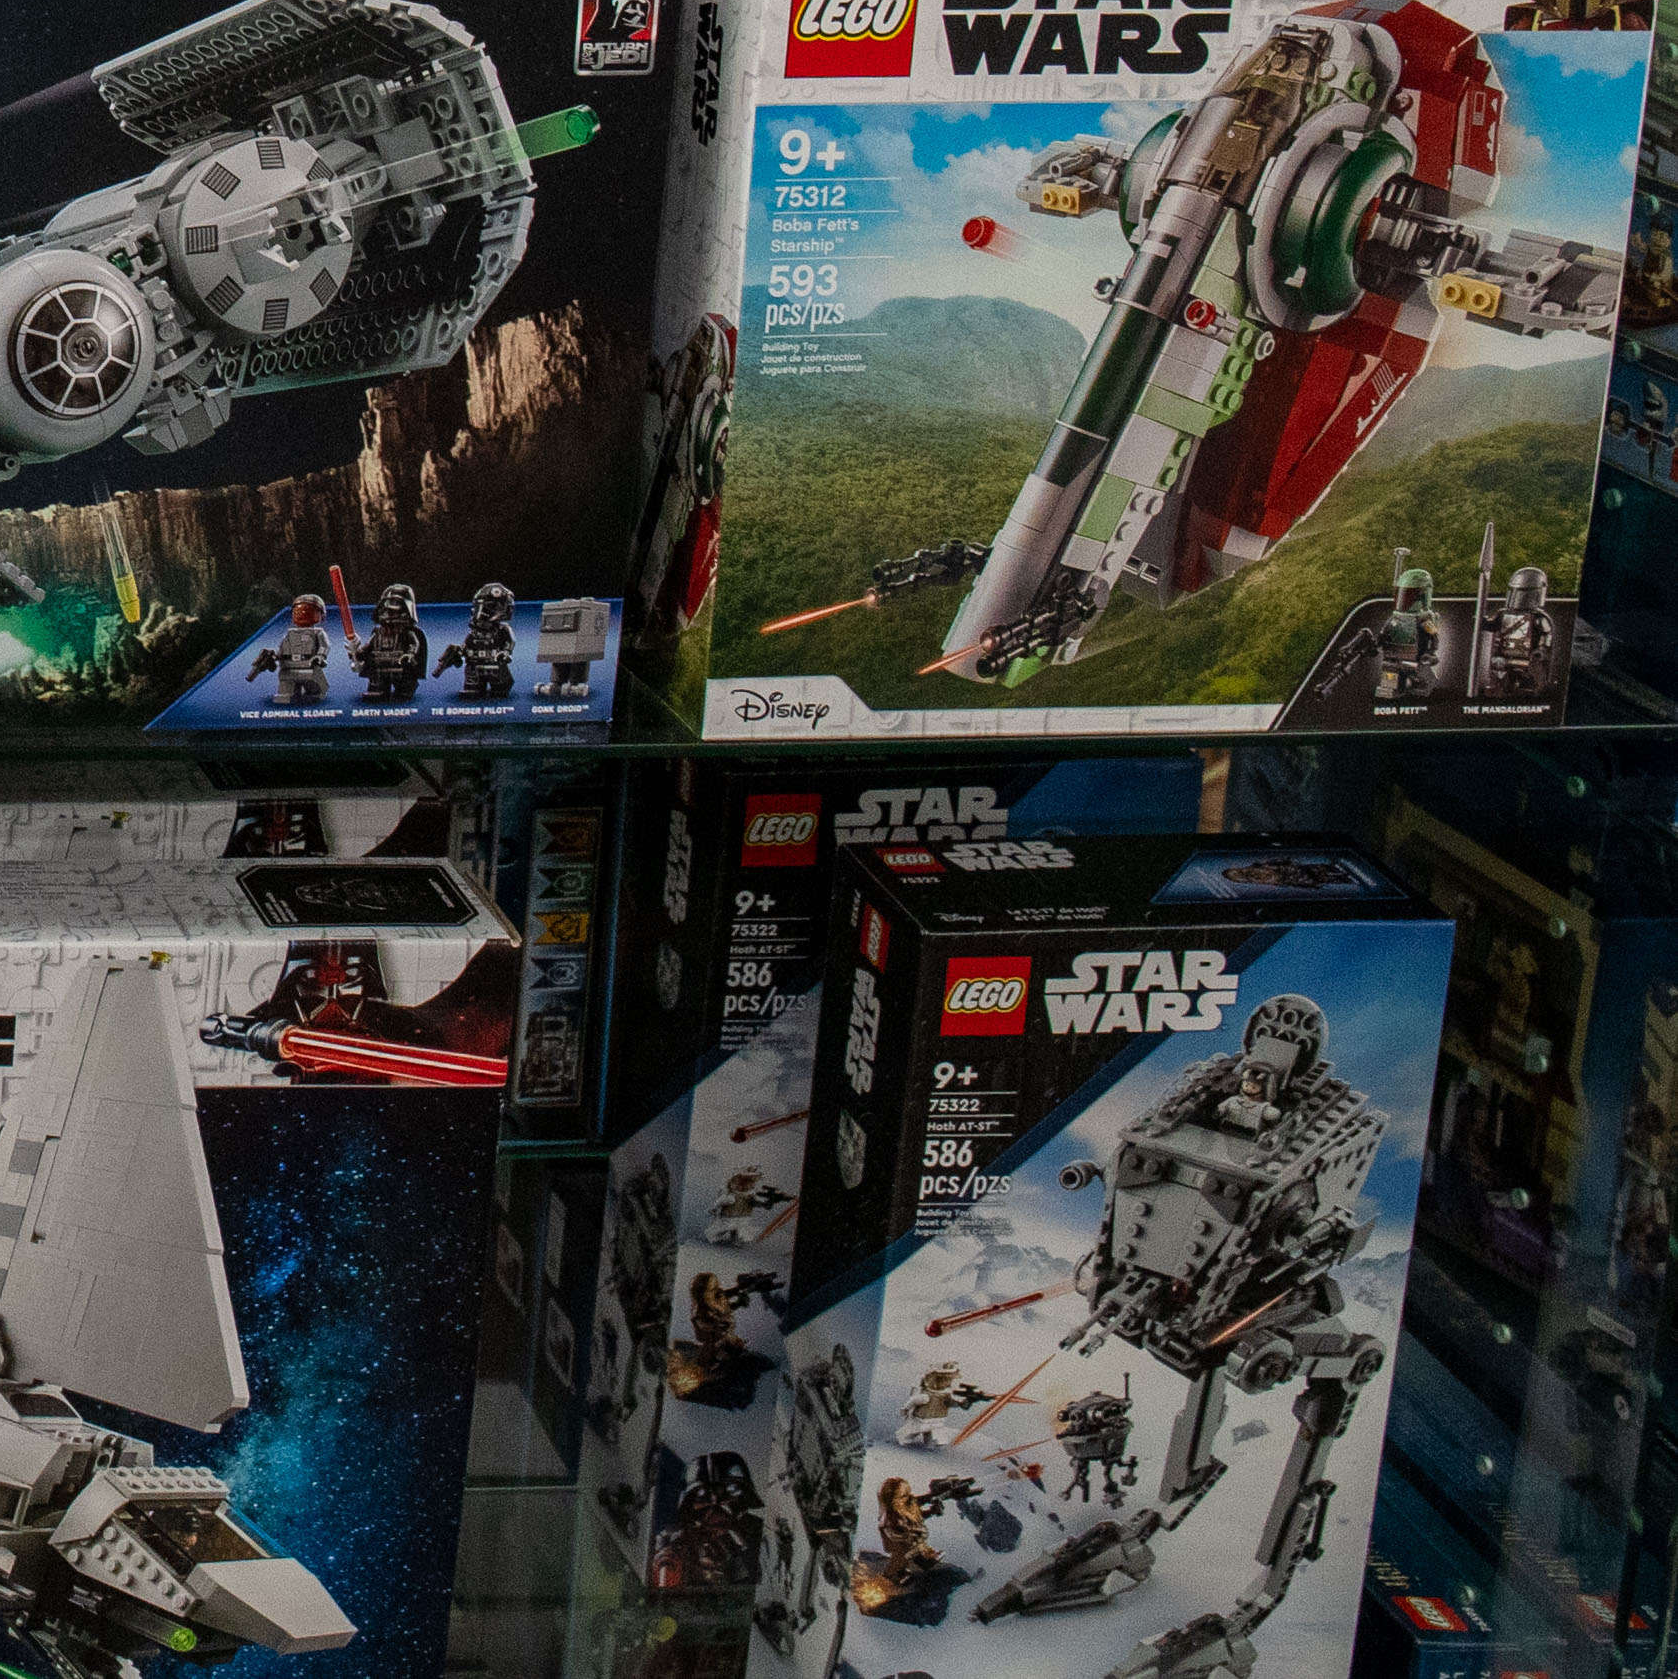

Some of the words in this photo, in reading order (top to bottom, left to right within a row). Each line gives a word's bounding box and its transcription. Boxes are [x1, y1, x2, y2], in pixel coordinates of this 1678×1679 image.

[943, 13, 1230, 76] WARS
[779, 129, 845, 175] 9+
[774, 185, 846, 207] 75312
[772, 219, 812, 233] Boba
[817, 218, 859, 232] Fett's
[768, 264, 838, 298] 593
[764, 296, 845, 333] pcs/pzs
[836, 787, 1007, 825] STAR
[747, 816, 813, 844] LEGO
[735, 890, 776, 915] 9+
[731, 924, 777, 936] 75322
[726, 962, 772, 987] 586
[1044, 950, 1238, 993] STAR
[724, 986, 807, 1017] pcs/pzs
[948, 981, 1023, 1010] LEGO
[1045, 990, 1238, 1034] WARS
[933, 1061, 978, 1089] 9+
[929, 1098, 980, 1112] 75322
[923, 1140, 973, 1168] 586
[919, 1166, 1012, 1200] pcs/pzs
